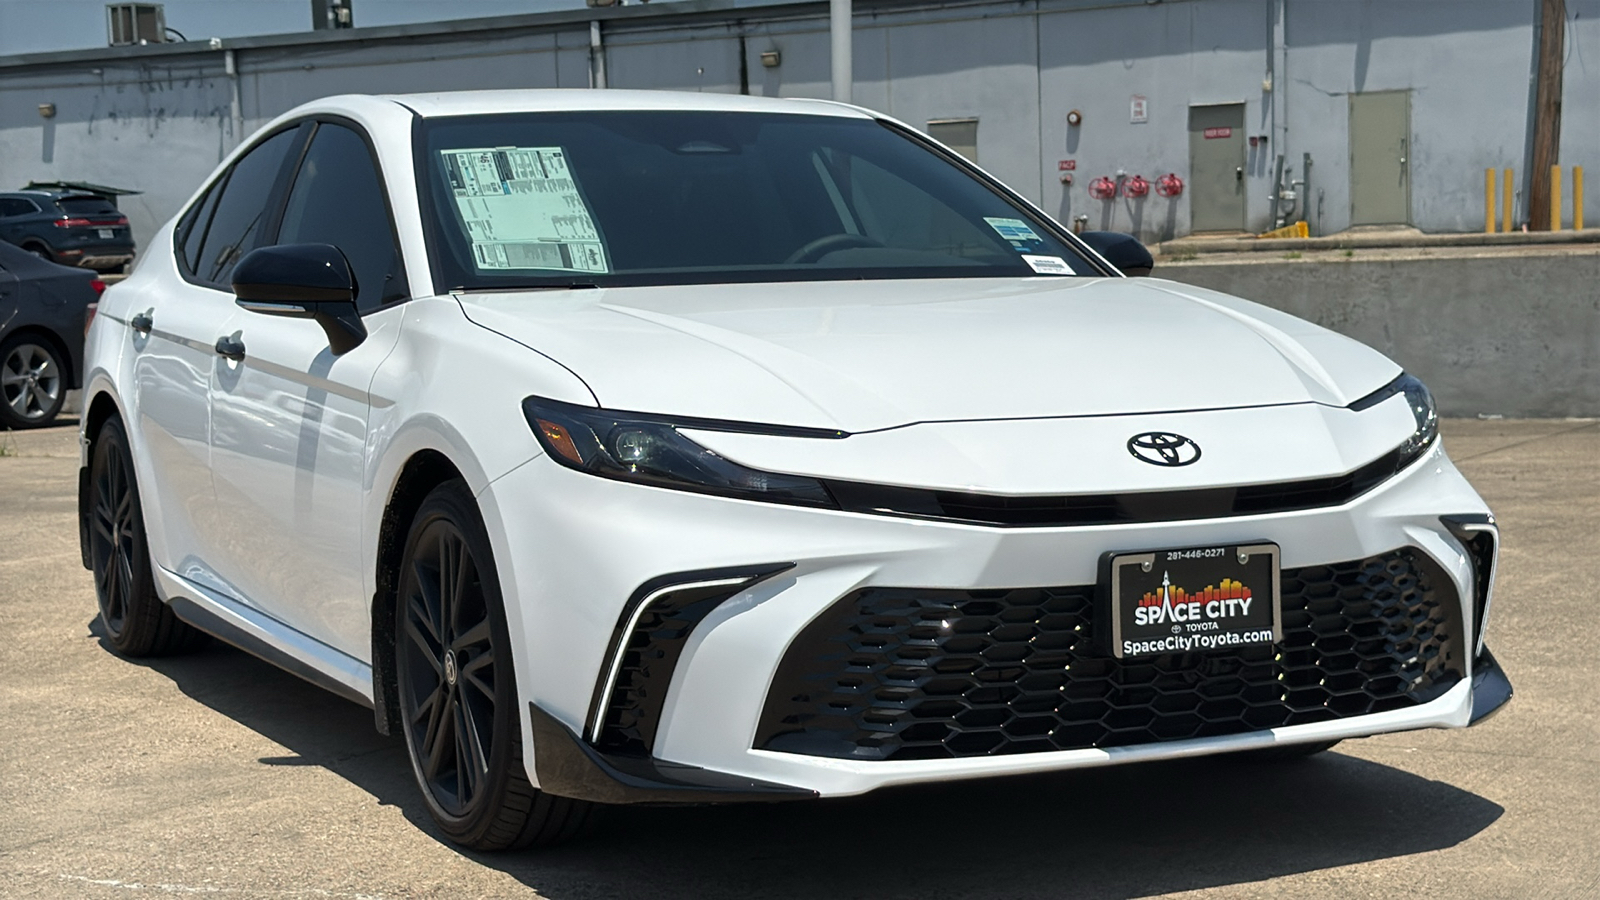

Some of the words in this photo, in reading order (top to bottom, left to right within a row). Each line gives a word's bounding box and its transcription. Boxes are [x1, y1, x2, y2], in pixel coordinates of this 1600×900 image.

[1166, 548, 1225, 561] 281-446-0271
[1134, 602, 1201, 625] SPACE
[1205, 597, 1252, 619] CITY
[1185, 621, 1218, 632] TOYOTA
[1123, 630, 1273, 656] SpaceCityToyota.com
